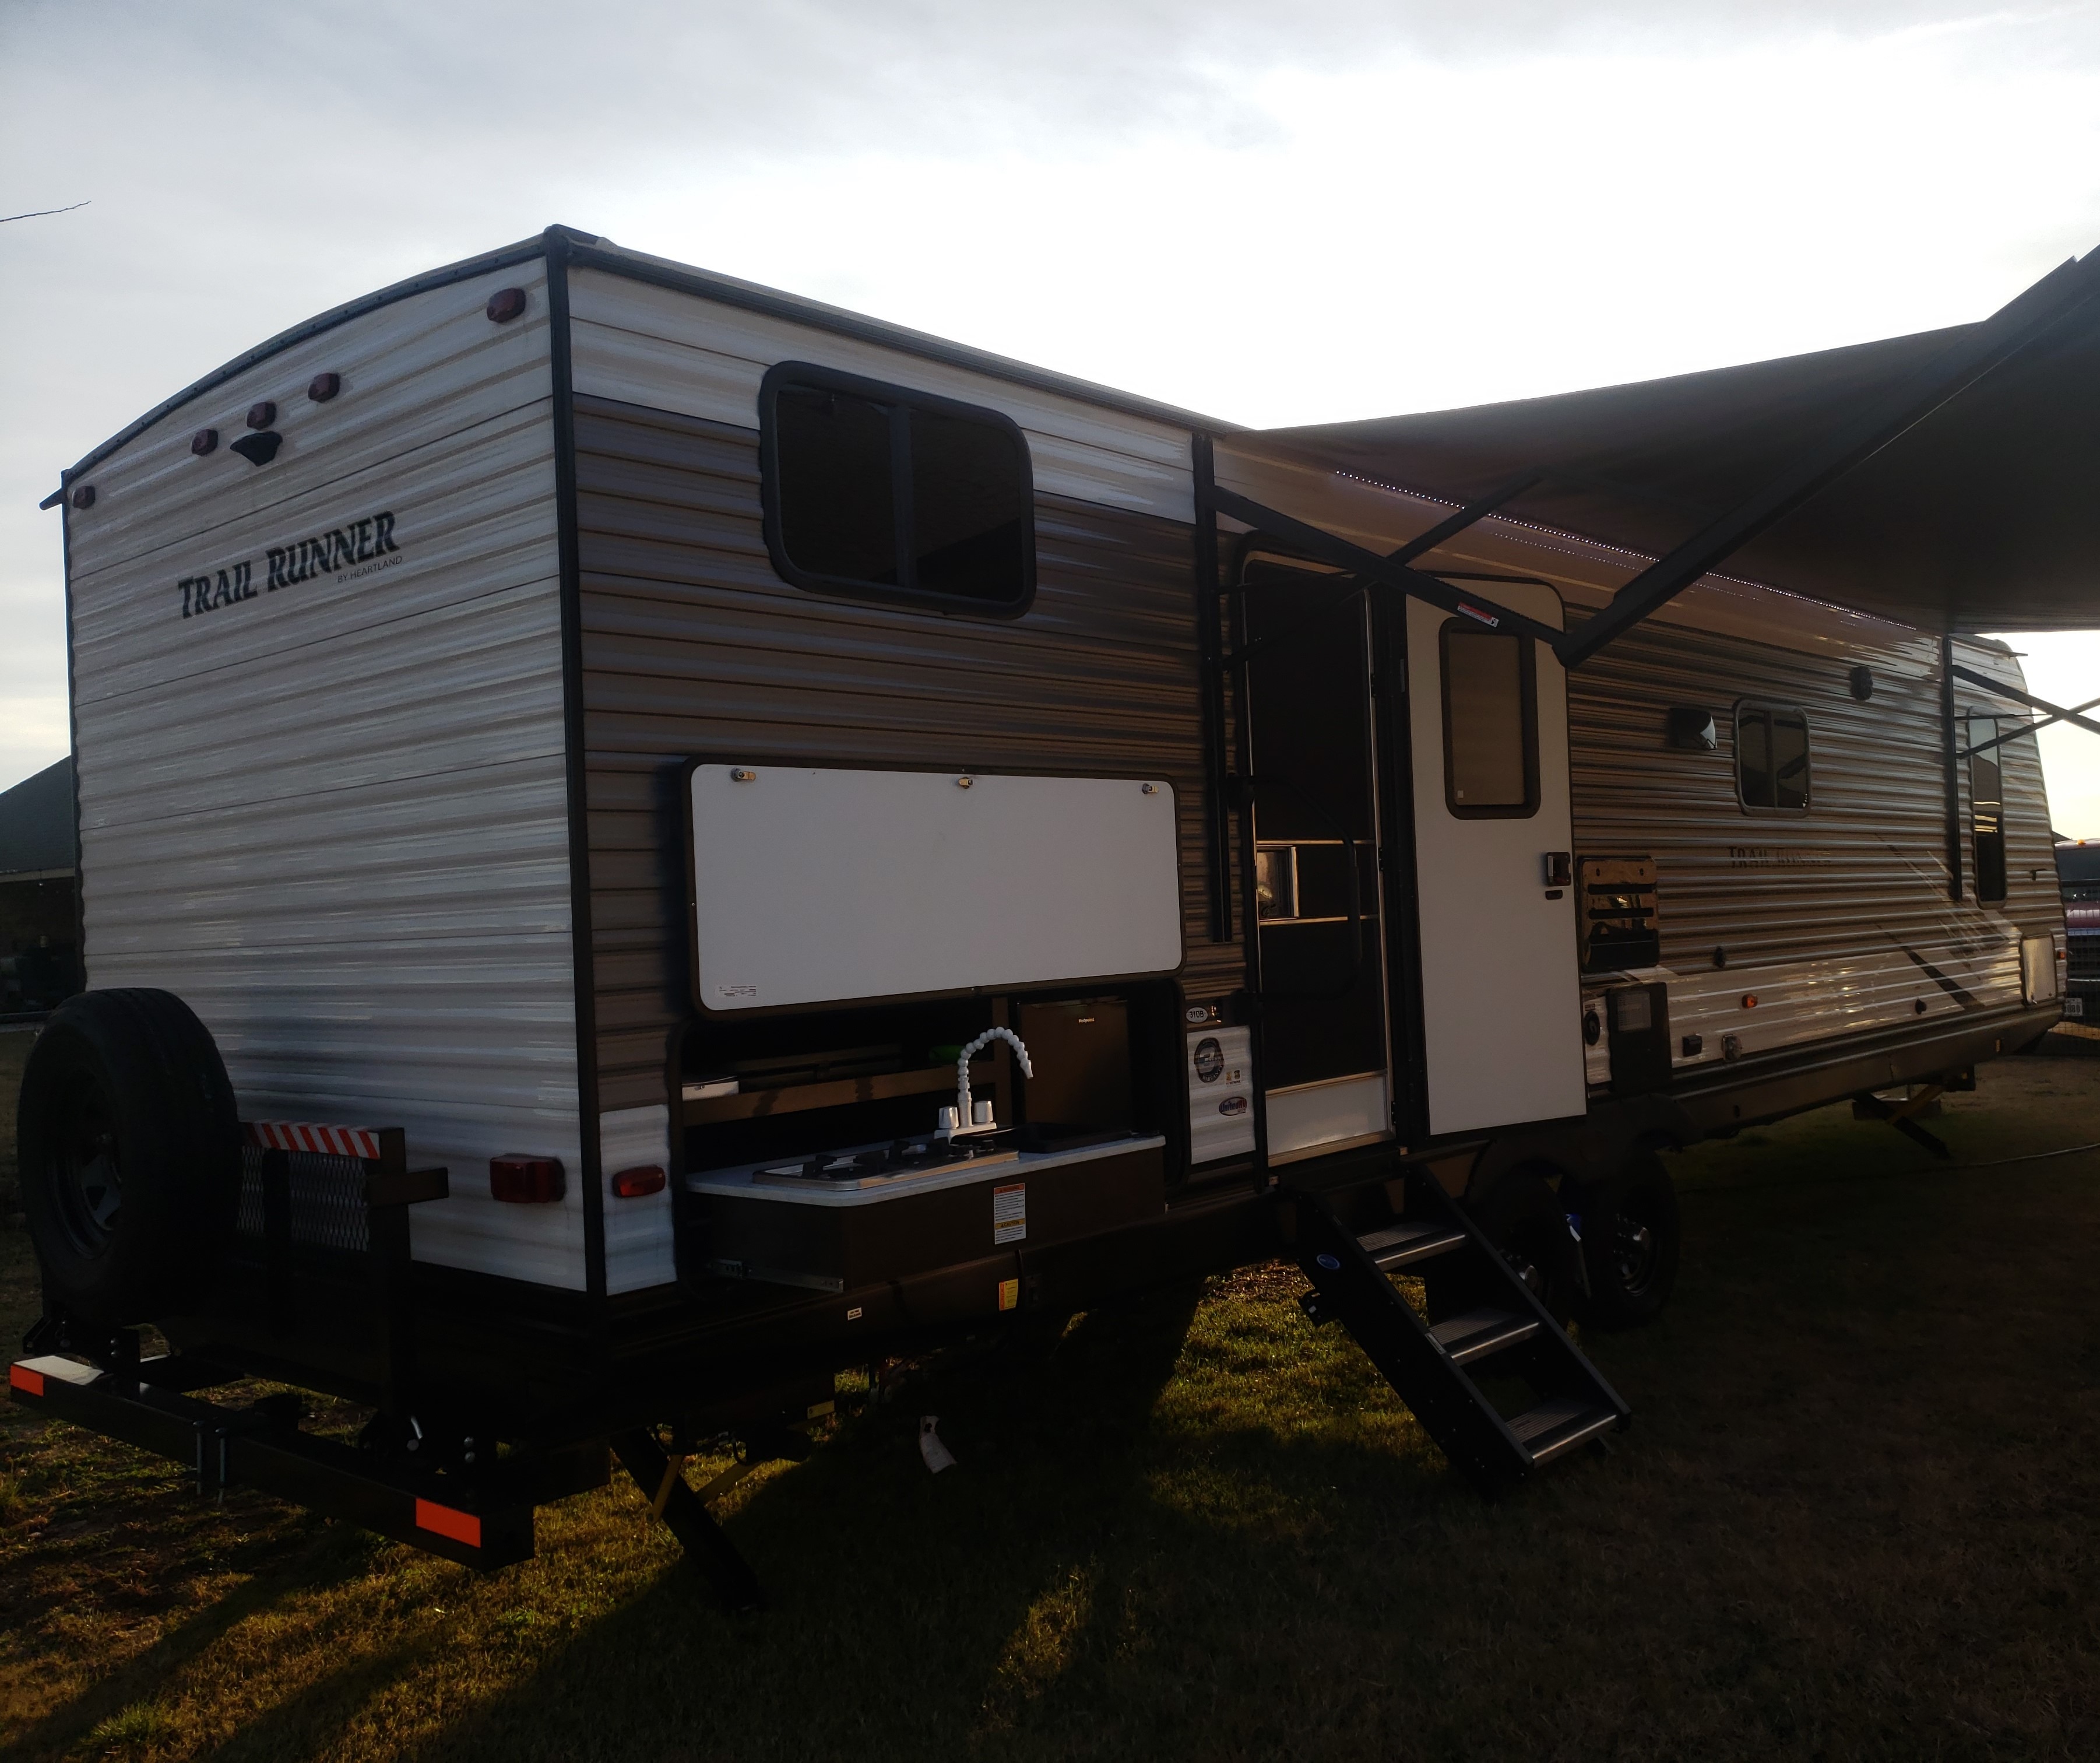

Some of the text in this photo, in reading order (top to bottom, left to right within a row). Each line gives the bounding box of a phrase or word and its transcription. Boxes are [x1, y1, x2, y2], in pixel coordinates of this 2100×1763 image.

[178, 511, 401, 619] TRAIL RUNNER
[338, 556, 402, 582] BY HEARTLAND
